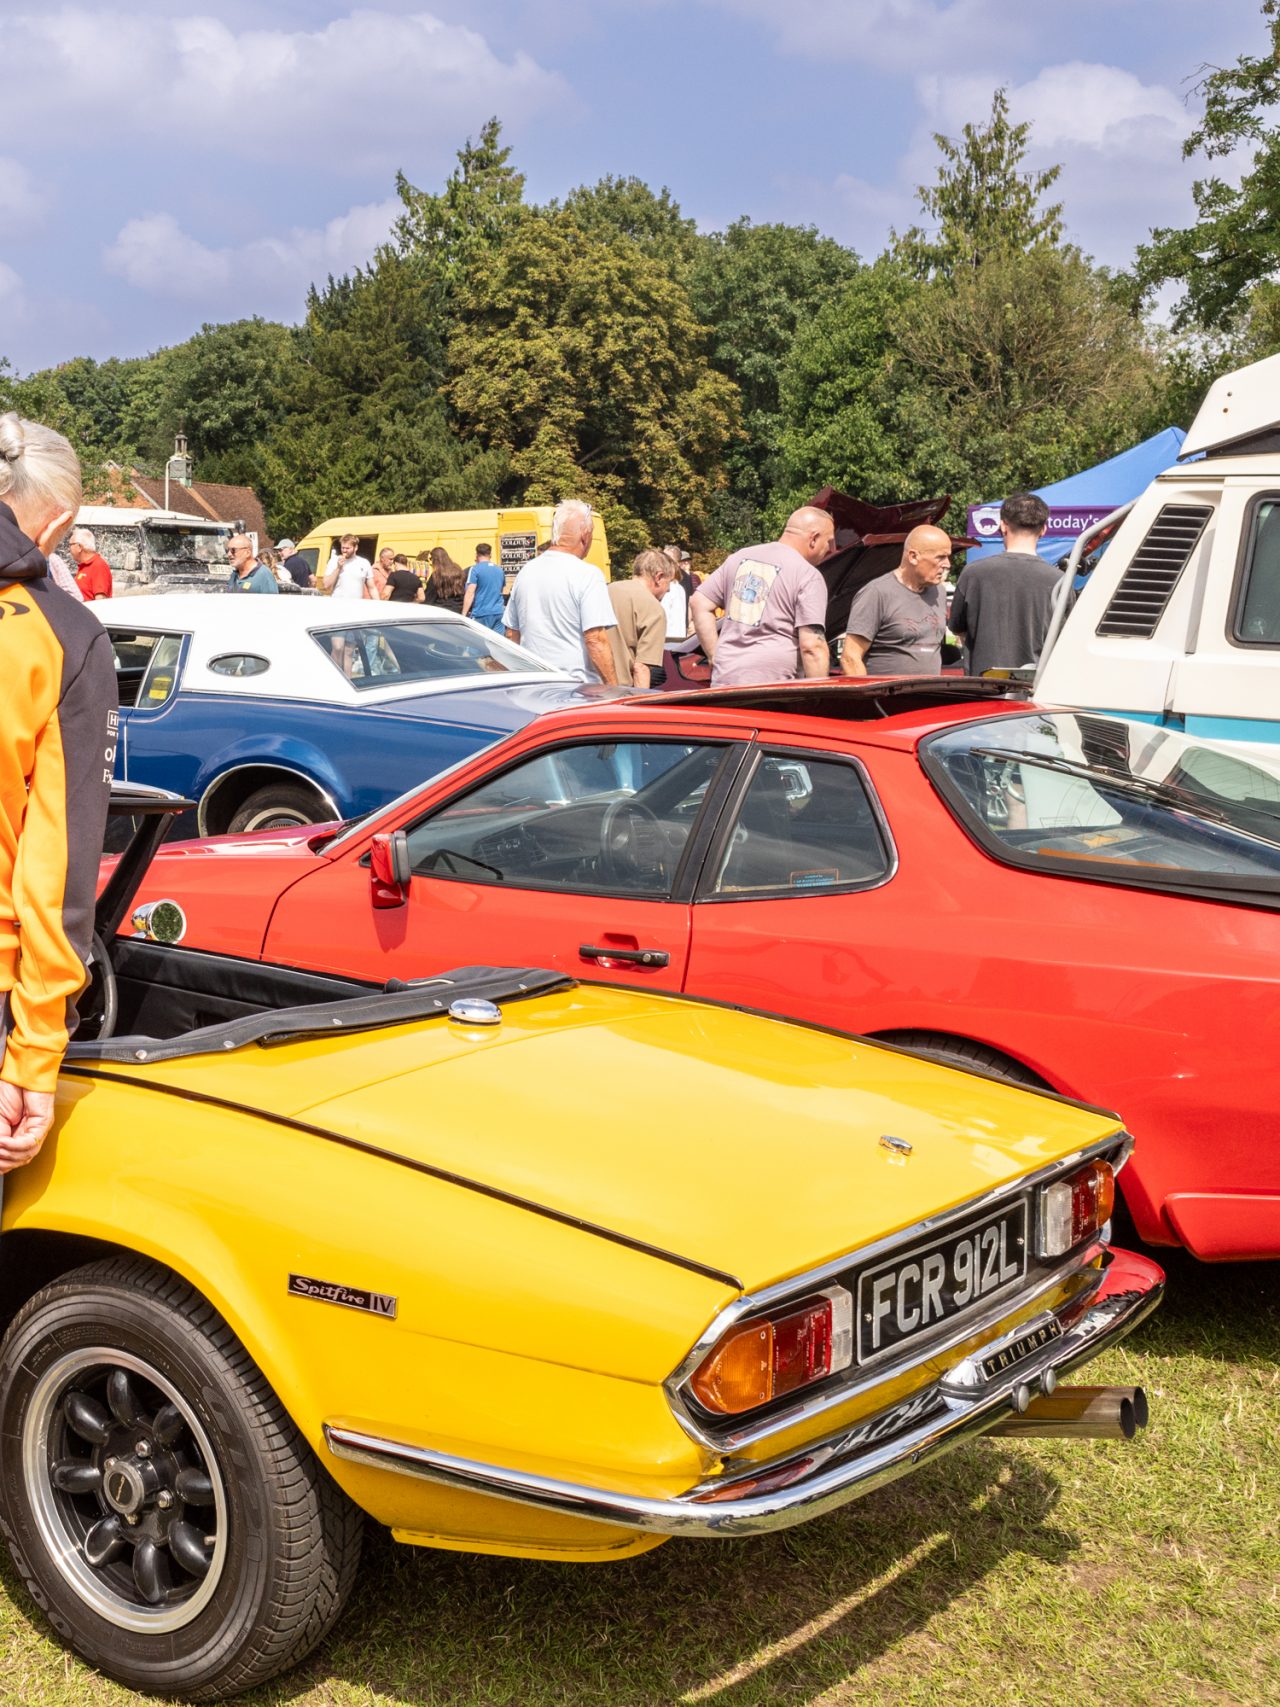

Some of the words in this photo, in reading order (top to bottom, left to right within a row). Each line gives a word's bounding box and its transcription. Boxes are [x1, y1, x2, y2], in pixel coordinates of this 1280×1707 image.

[293, 1278, 365, 1305] Spitfire
[373, 1295, 393, 1313] IV
[873, 1253, 946, 1349] FCR
[953, 1220, 1018, 1306] 912L
[987, 1322, 1060, 1374] TRIUMPH
